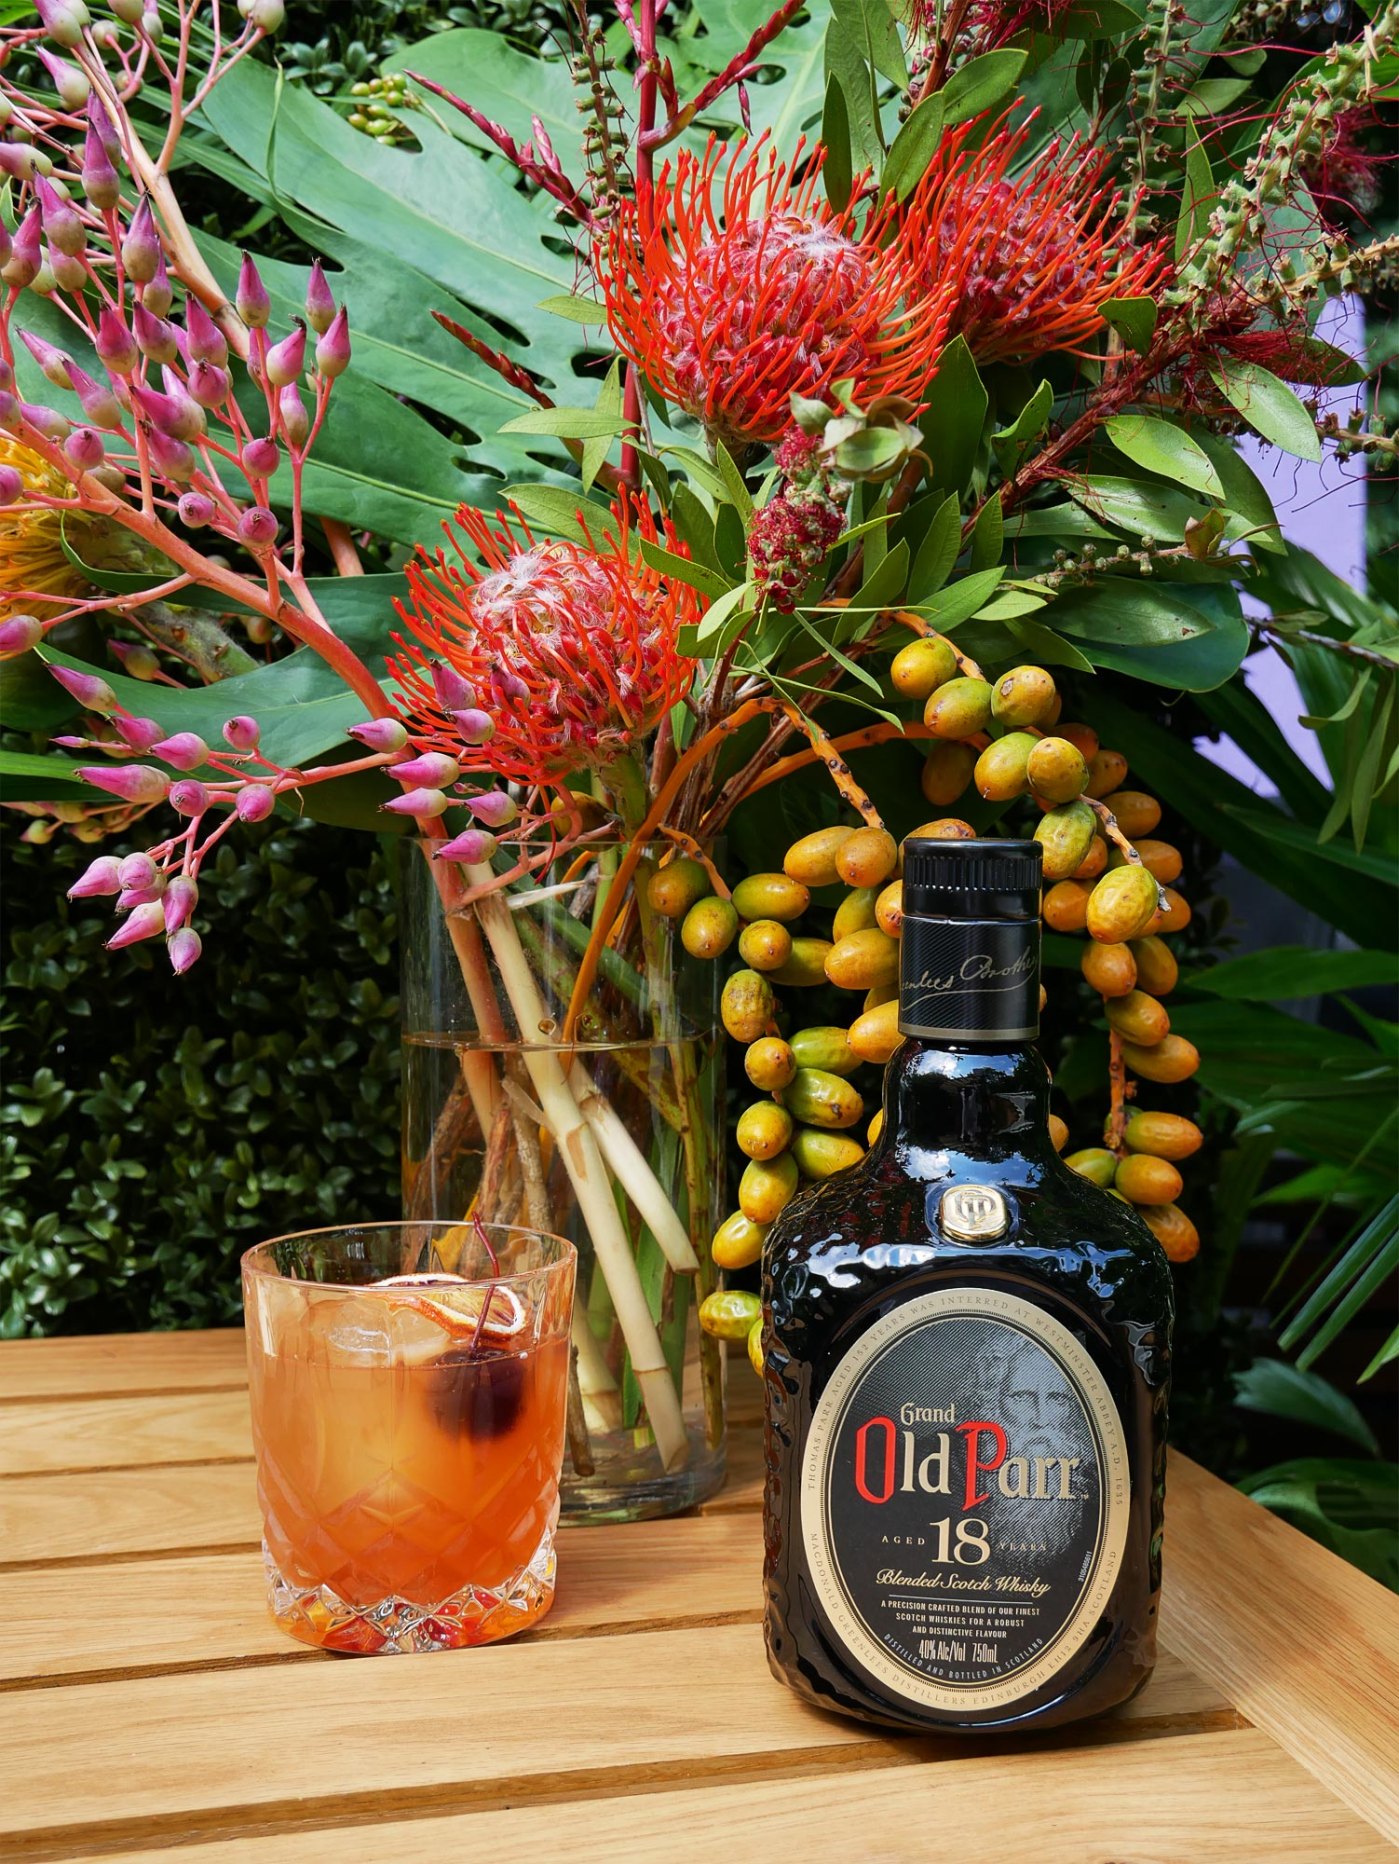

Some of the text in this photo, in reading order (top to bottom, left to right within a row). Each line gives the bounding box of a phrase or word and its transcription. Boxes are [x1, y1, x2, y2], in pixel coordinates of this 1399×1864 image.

[807, 1437, 822, 1491] THOMAS
[817, 1401, 833, 1432] PARR
[831, 1365, 852, 1396] AGED
[870, 1313, 906, 1341] YEARS
[910, 1301, 935, 1315] WAS
[941, 1296, 1009, 1310] INTERRED
[1015, 1307, 1031, 1319] AT
[1035, 1318, 1098, 1392] WESTMINSTER
[1096, 1396, 1115, 1436] ABBEY
[900, 1402, 956, 1426] Grand
[855, 1415, 1083, 1511] Old Parr
[881, 1516, 1048, 1566] AGED 18 YEARS
[875, 1568, 1052, 1599] Blended Scotch Whisky
[810, 1532, 839, 1611] MACDONALD
[837, 1614, 889, 1675] GREENLEES
[892, 1674, 966, 1705] DISTILLERS
[973, 1670, 1046, 1704] EDINBURGH
[1088, 1550, 1117, 1616] SCOTLAND
[881, 1600, 1040, 1616] A PRECISION CRAFTED BLEND OF OUR FINEST
[895, 1613, 1025, 1627] SCOTCH WHISKIES FOR A ROBUST
[912, 1626, 1007, 1639] AND DISTINCTIVE FLAVOUR
[883, 1633, 1044, 1680] DISTILLED AND BOTTLED IN SCOTLAND
[918, 1639, 999, 1664] 40% Alc/Vol 750mL
